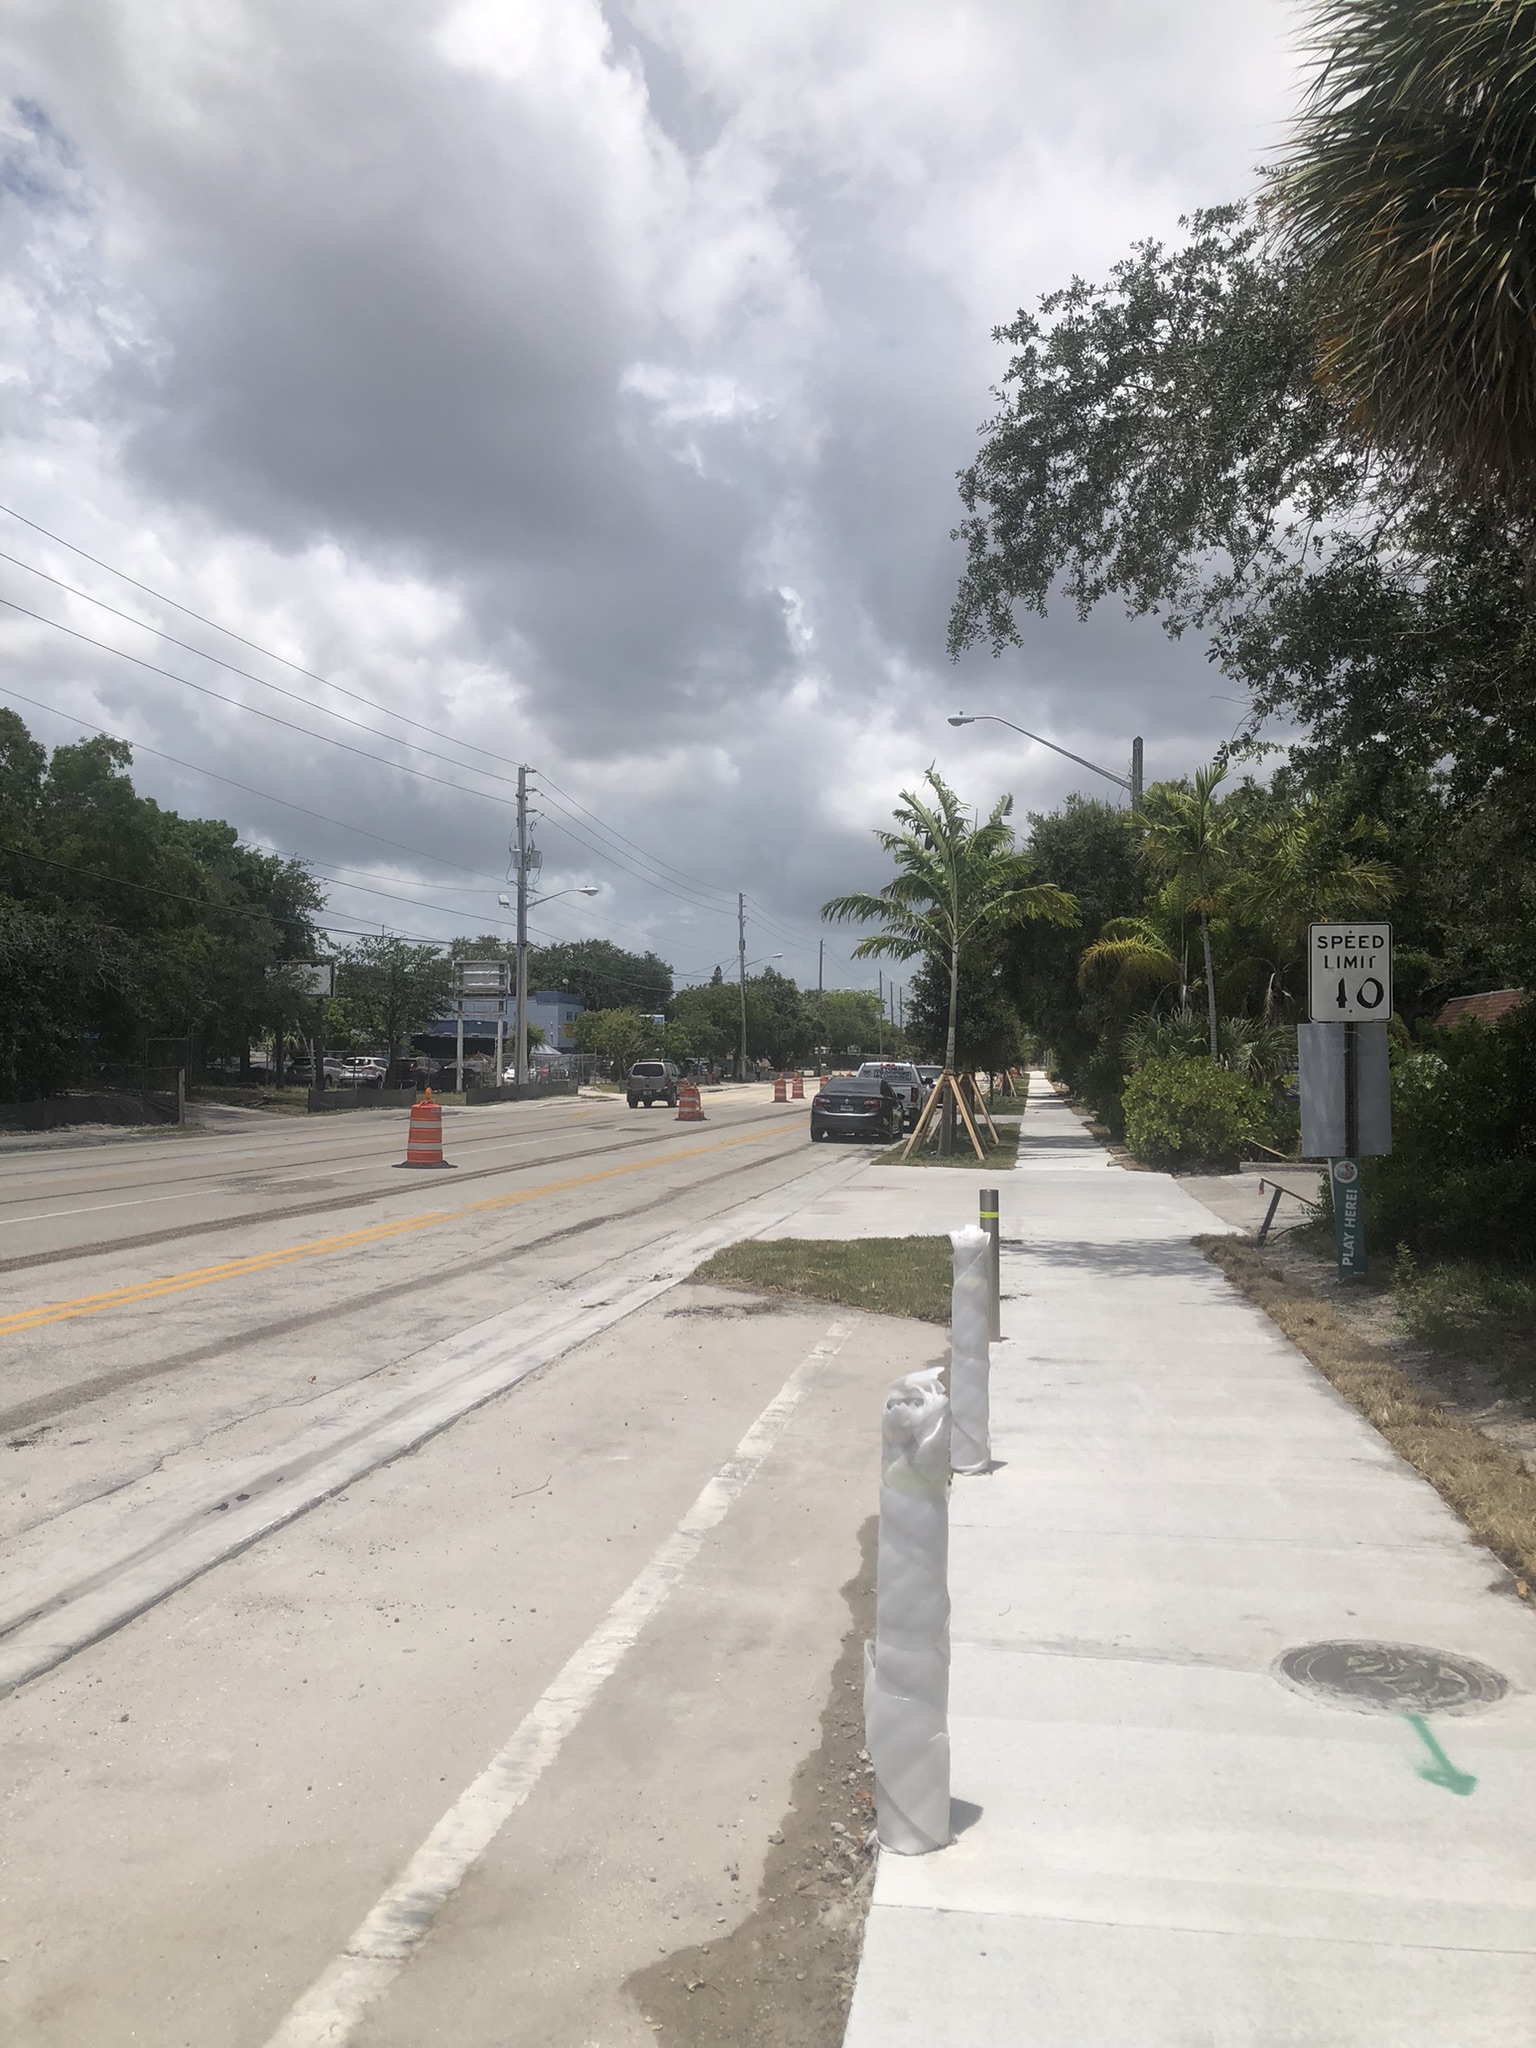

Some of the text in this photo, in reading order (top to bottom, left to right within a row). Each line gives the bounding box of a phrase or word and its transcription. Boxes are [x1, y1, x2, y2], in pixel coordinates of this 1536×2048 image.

[1317, 935, 1384, 949] SPEED
[1324, 955, 1376, 969] LIMIT
[1344, 1190, 1358, 1228] HERE!
[1342, 1232, 1355, 1266] PLAY
